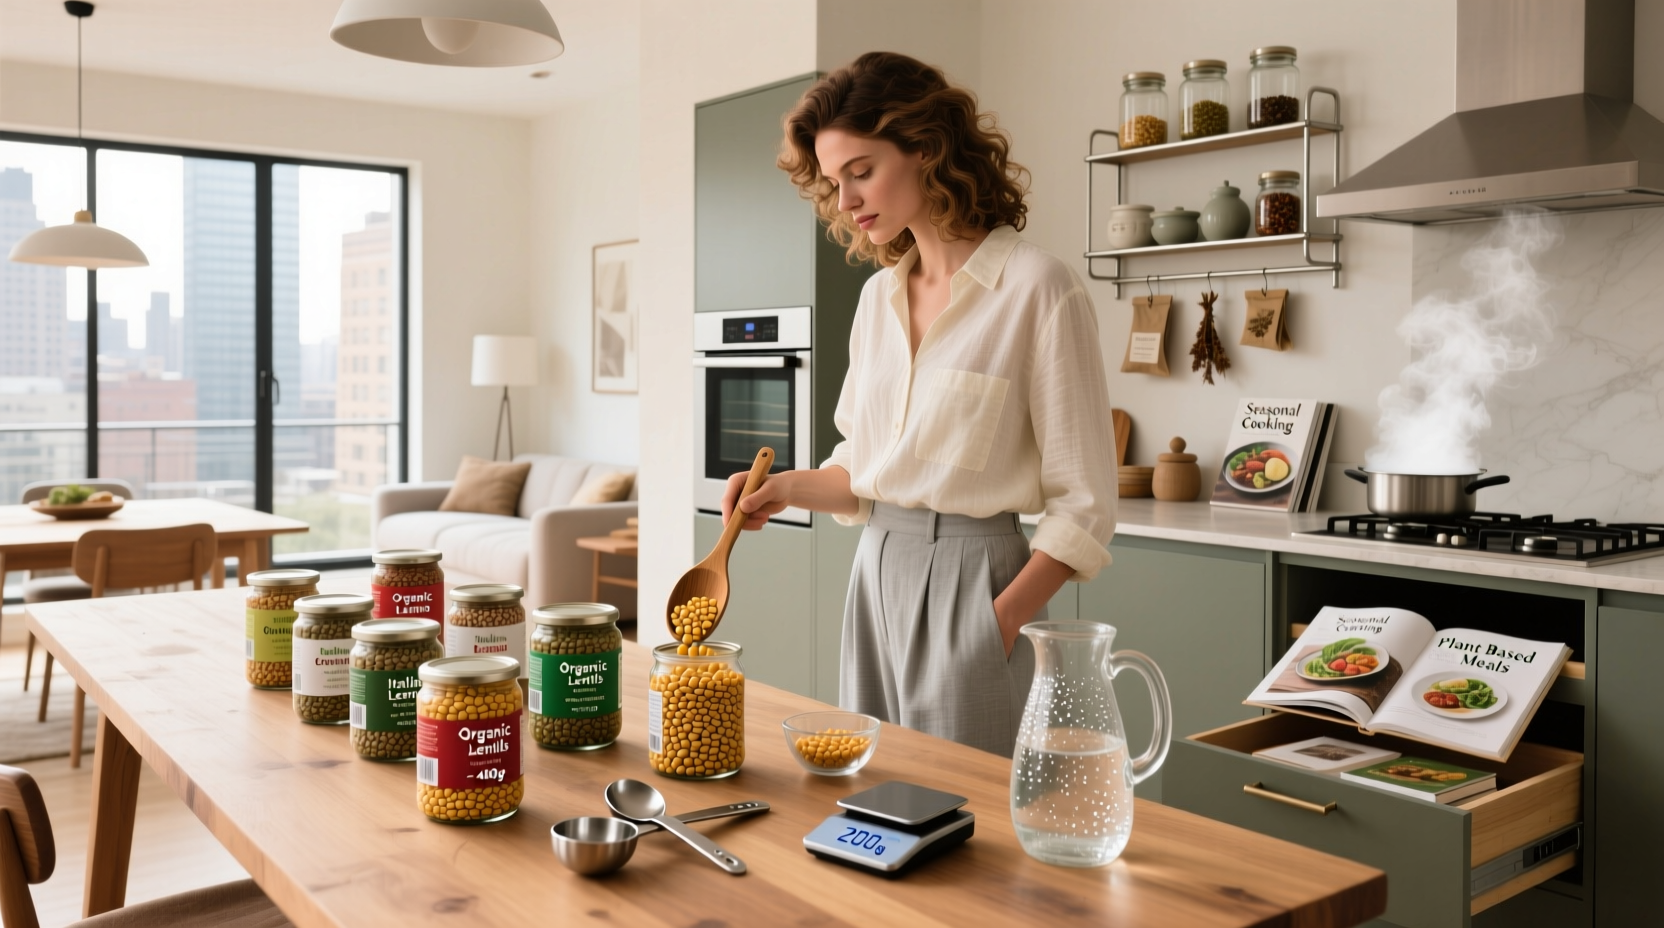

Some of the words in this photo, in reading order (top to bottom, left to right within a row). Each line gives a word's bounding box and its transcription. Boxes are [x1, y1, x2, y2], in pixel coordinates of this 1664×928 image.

[1244, 402, 1302, 417] Seasonal
[1242, 417, 1294, 435] Cooking
[1438, 637, 1482, 653] Plant
[1485, 644, 1537, 664] Based
[560, 660, 607, 676] Organic
[1461, 654, 1510, 673] Meals
[458, 723, 511, 744] Organic
[468, 739, 509, 756] Lentils
[837, 826, 886, 855] 200g
